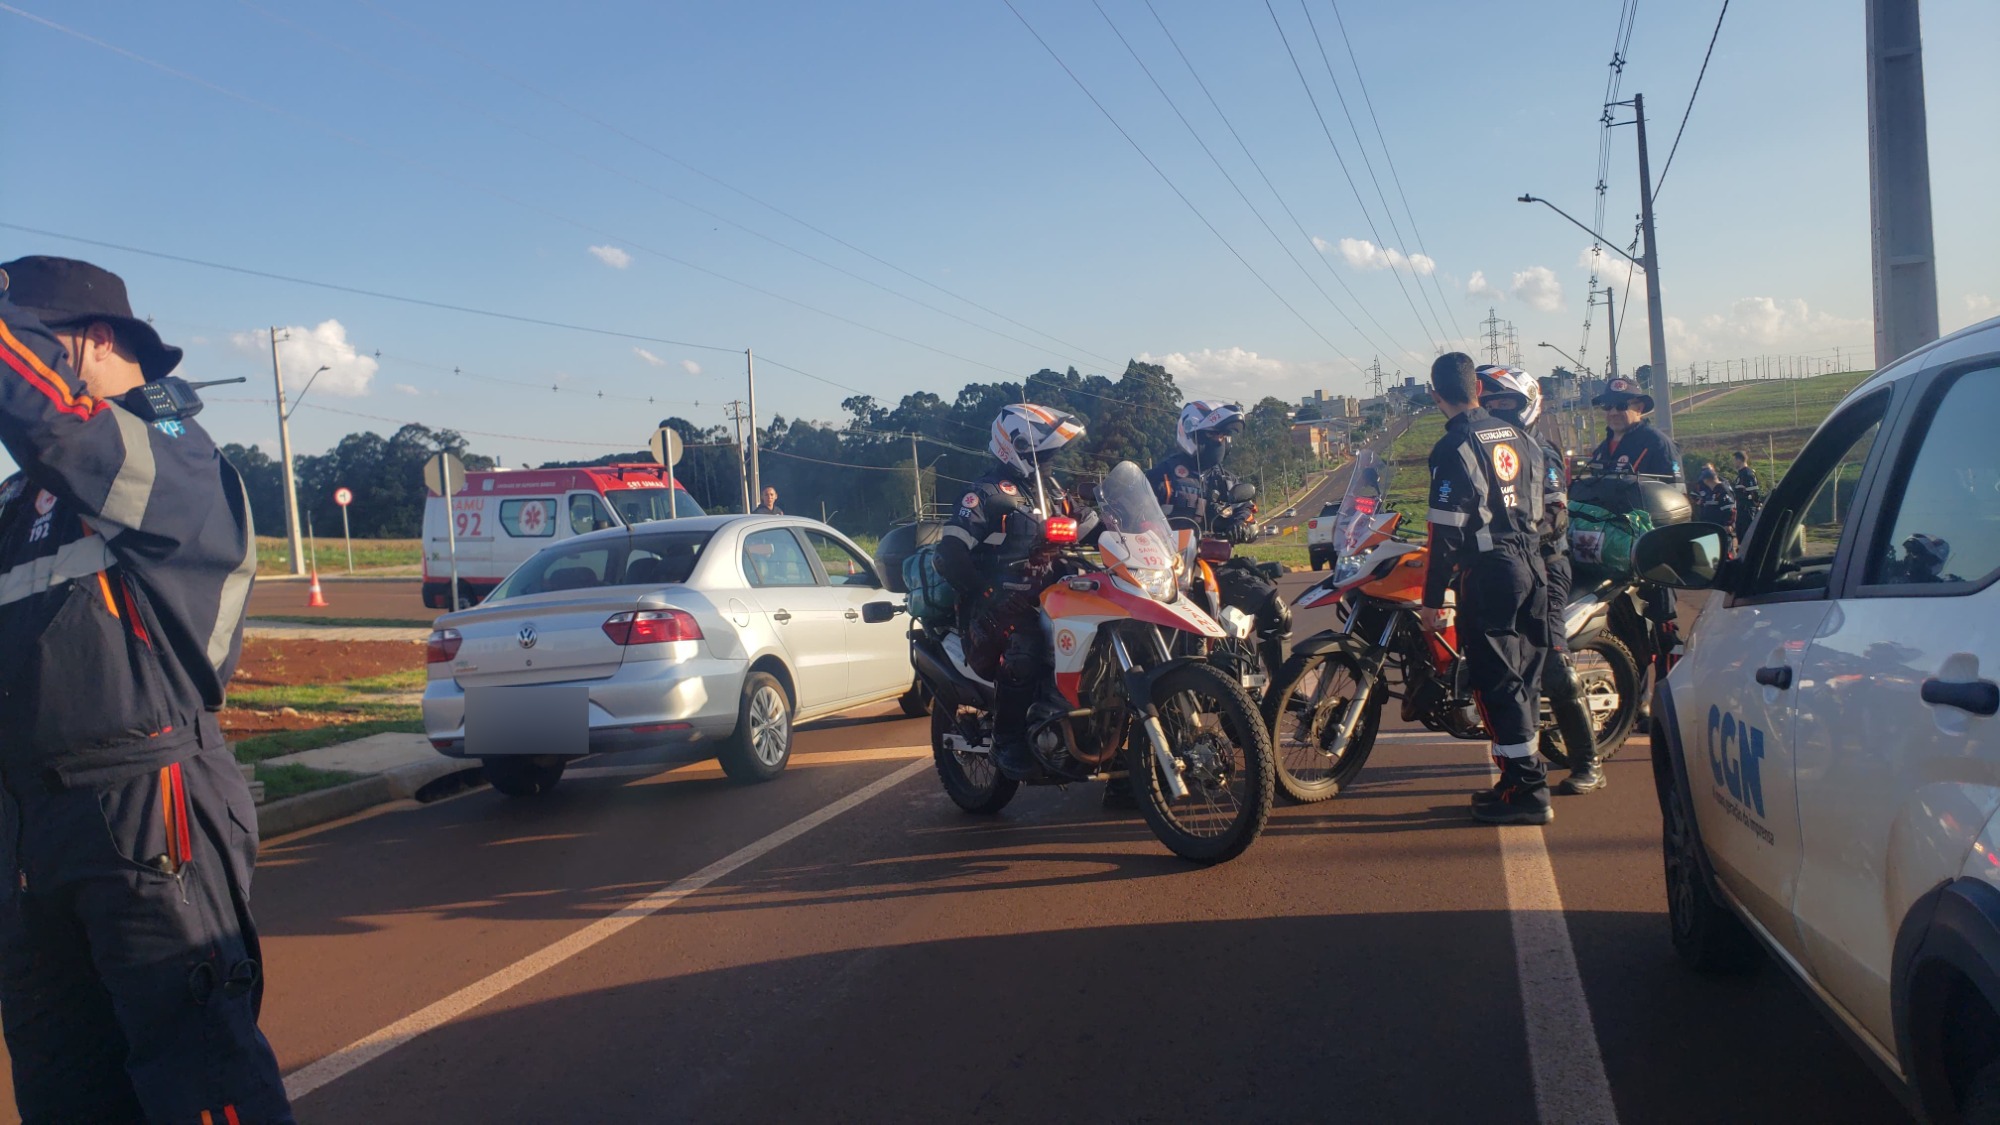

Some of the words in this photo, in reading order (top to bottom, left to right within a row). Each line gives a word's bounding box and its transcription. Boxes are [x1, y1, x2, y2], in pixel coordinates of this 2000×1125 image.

[454, 499, 485, 511] AMU
[1503, 494, 1517, 507] 92
[29, 522, 50, 543] 192
[456, 512, 482, 537] 92
[1143, 555, 1164, 567] 192
[1749, 812, 1775, 847] imprensa
